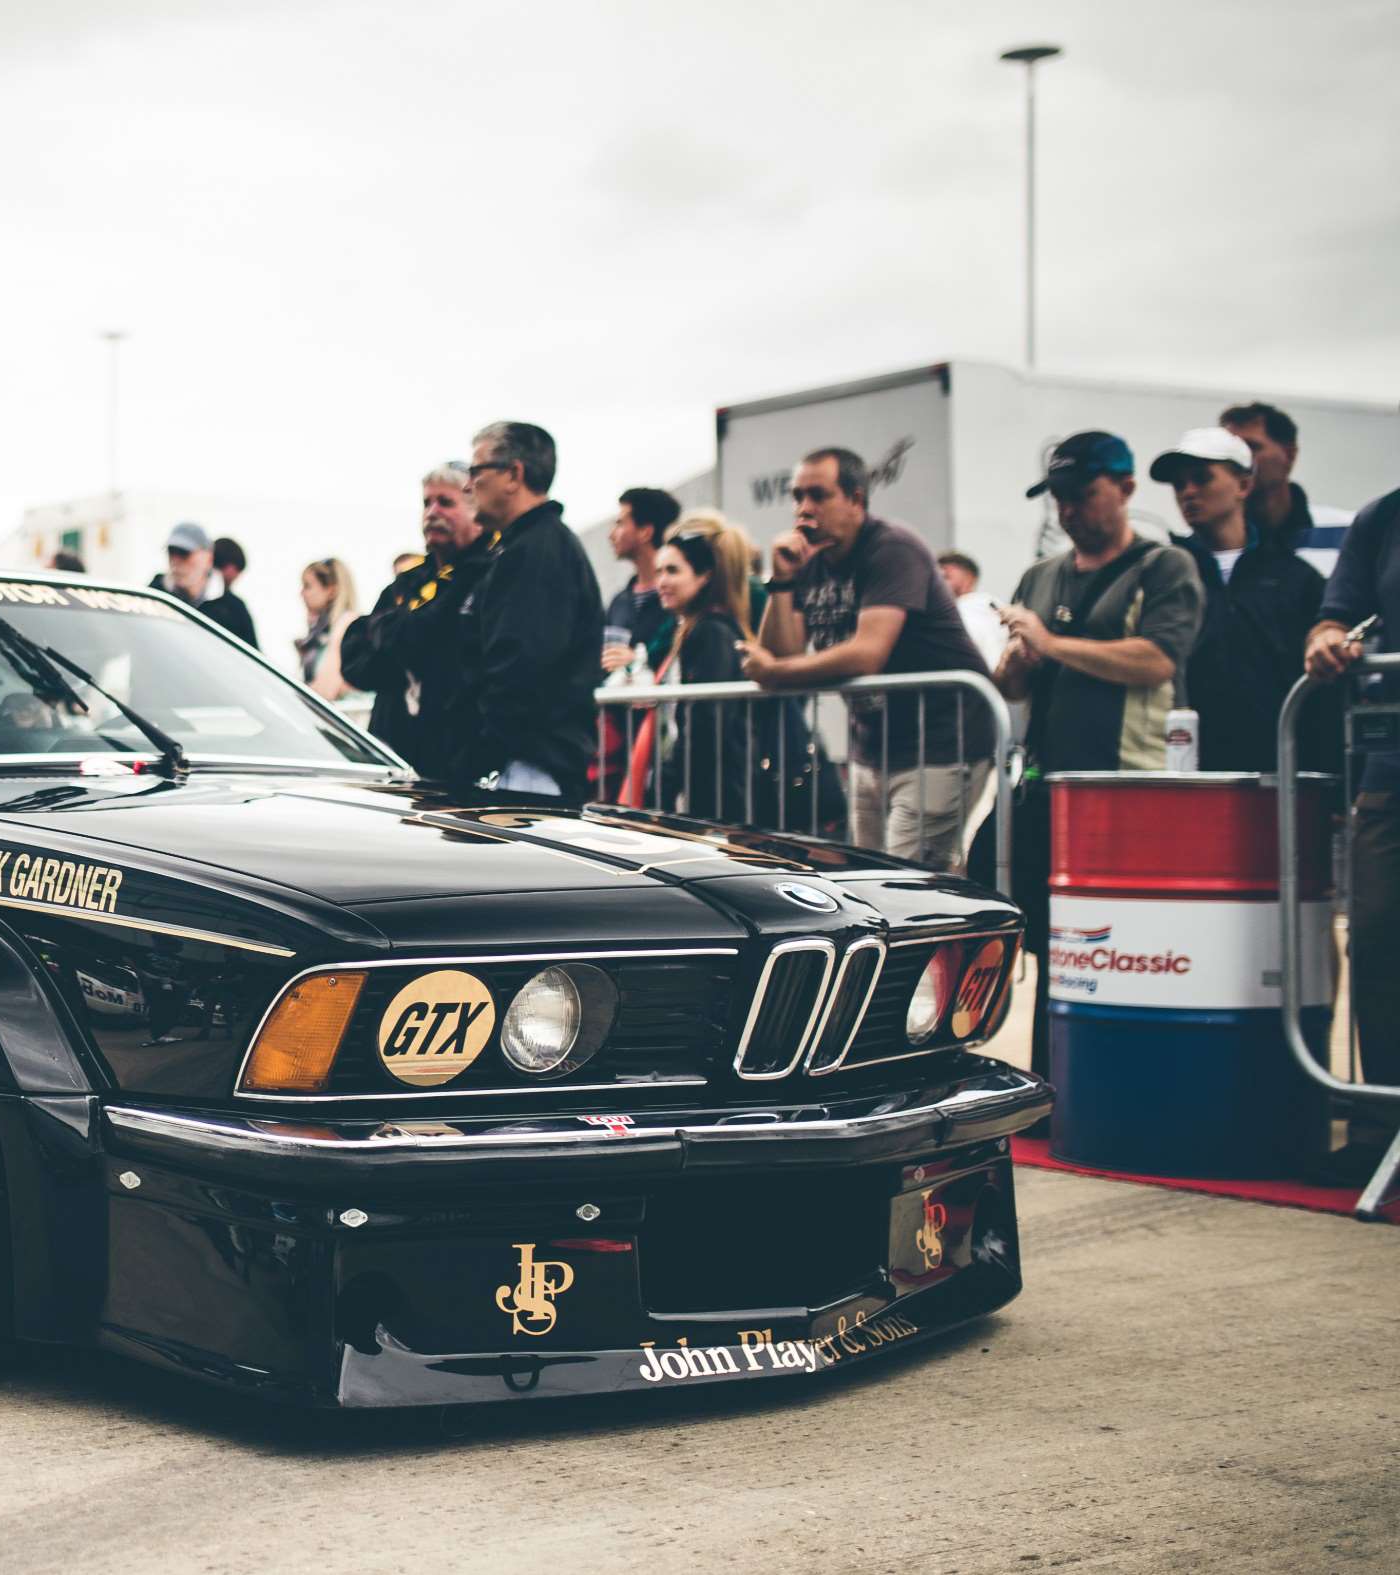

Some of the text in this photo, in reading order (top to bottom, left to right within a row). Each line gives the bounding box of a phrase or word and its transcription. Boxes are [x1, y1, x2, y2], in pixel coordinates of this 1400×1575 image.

[9, 852, 123, 914] GARDNER
[382, 1001, 490, 1057] GTX
[639, 1310, 919, 1382] John Player & Sons
